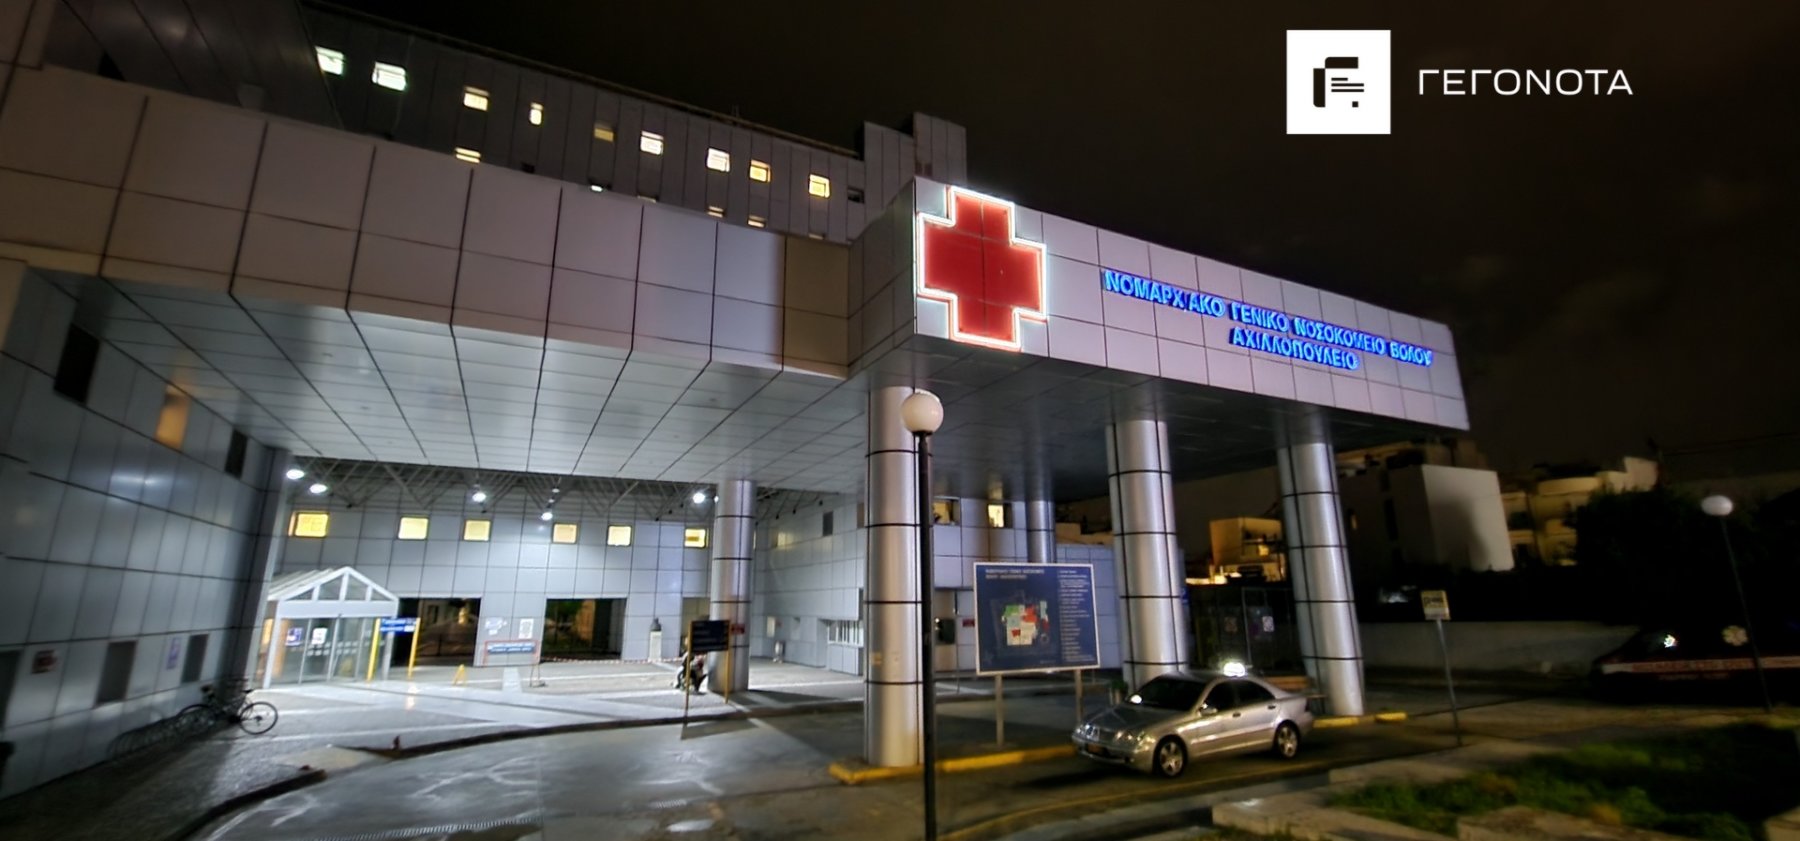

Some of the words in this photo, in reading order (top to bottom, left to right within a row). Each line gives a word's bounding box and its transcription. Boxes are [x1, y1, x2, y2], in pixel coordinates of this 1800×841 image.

[1230, 303, 1290, 334] ΓΕΝΙΚΟ
[1293, 316, 1386, 356] ΝΟΣΟΚΟΜΕΙΟ
[1389, 341, 1433, 367] ΒΟΛΟΥ
[1231, 326, 1360, 371] ΑΧΙΛΛΟΠΟΥΛΕΙΟ
